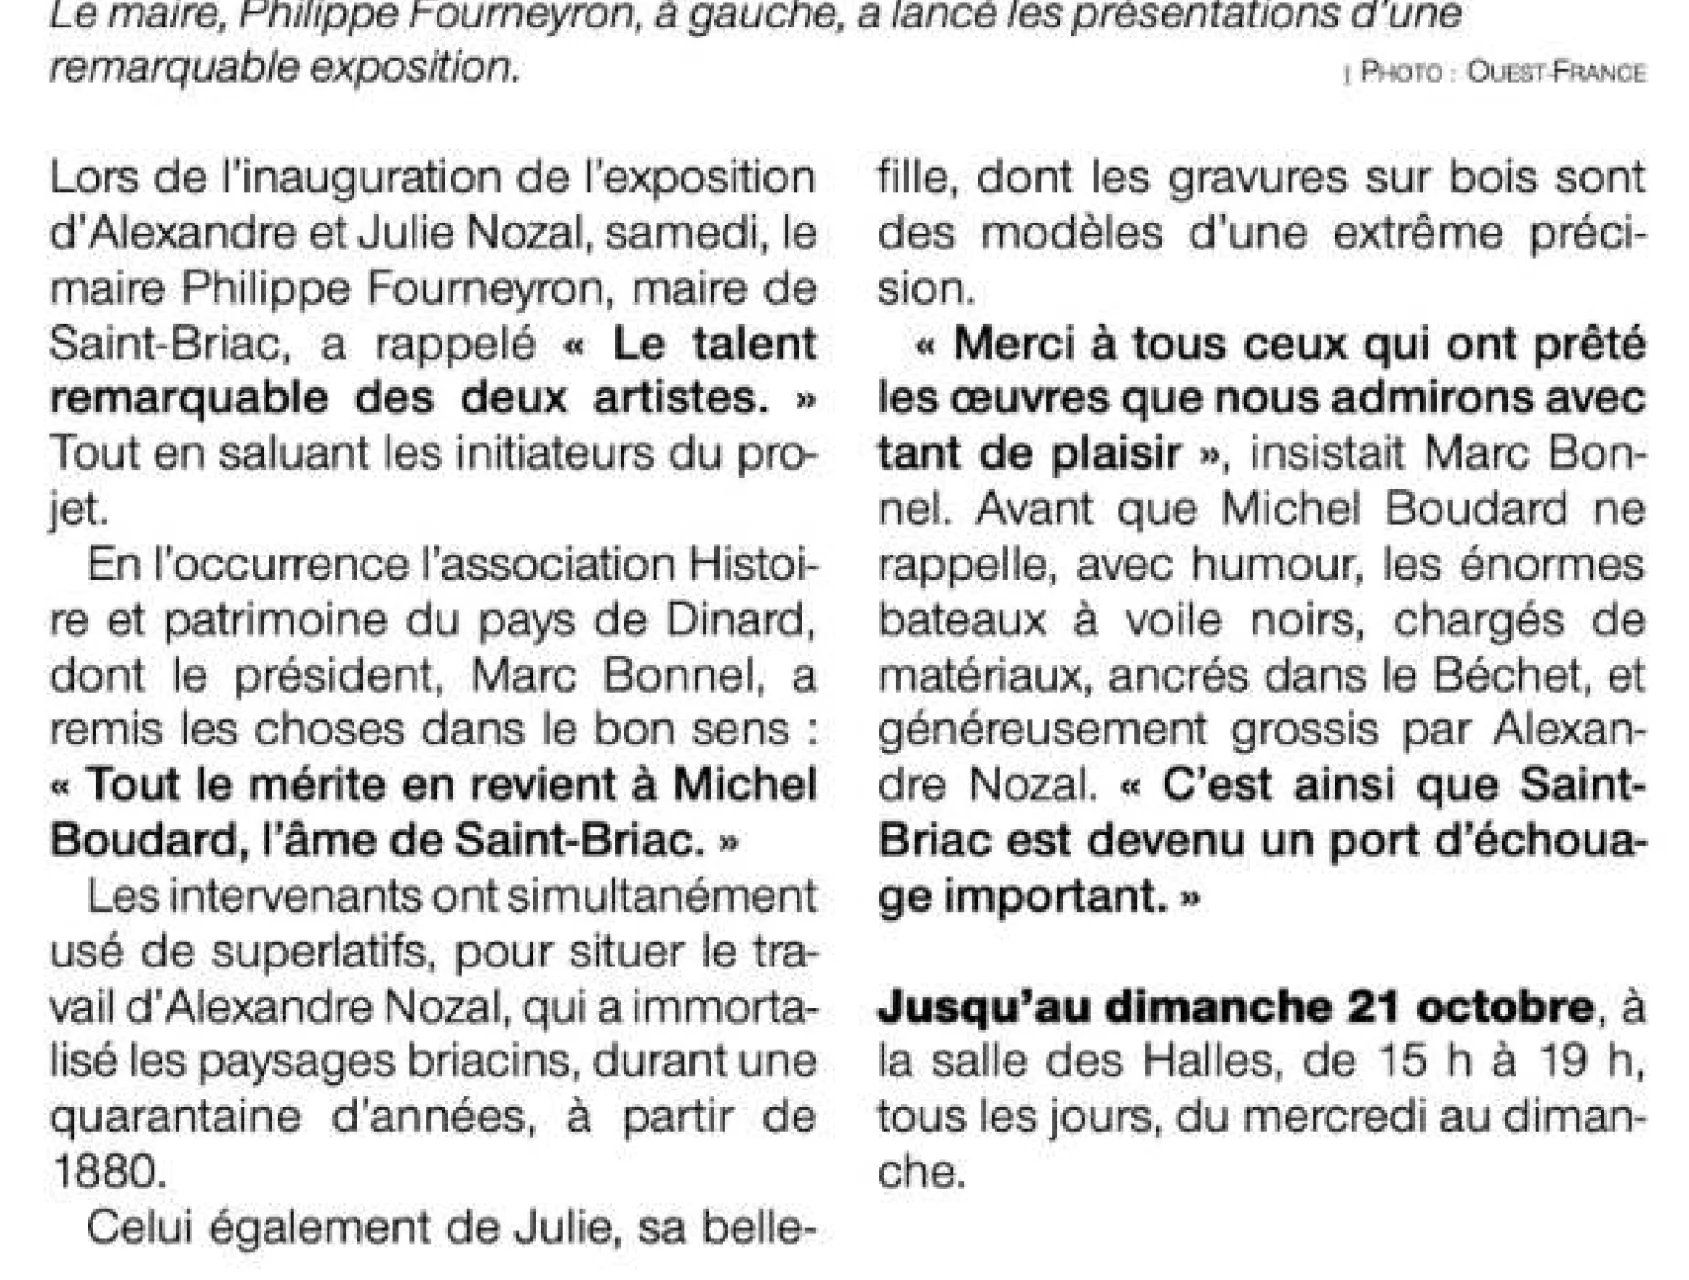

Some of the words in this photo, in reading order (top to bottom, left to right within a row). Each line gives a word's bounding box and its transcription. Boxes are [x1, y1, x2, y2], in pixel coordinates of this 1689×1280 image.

[858, 3, 881, 29] a
[50, 50, 302, 92] remarquable
[311, 50, 521, 92] exposition.
[52, 159, 140, 195] Lors
[154, 157, 208, 195] de
[225, 157, 503, 205] l'inauguration
[516, 159, 571, 195] de
[587, 157, 815, 203] l'exposition
[876, 157, 959, 200] fille,
[978, 159, 1073, 195] dont
[1094, 159, 1151, 195] les
[1170, 167, 1348, 205] gravures
[1367, 167, 1433, 195] sur
[1451, 157, 1538, 195] bois
[1557, 160, 1648, 195] sont
[52, 270, 167, 307] maire
[184, 269, 354, 315] Philippe
[371, 269, 614, 315] Fourneyron,
[635, 269, 750, 307] maire
[764, 269, 818, 307] de
[879, 269, 975, 307] sion.
[879, 379, 941, 417] les
[950, 387, 1112, 417] œuvres
[1123, 387, 1205, 425] que
[1217, 387, 1323, 417] nous
[1332, 376, 1537, 417] admirons
[1546, 387, 1648, 417] avec
[49, 433, 142, 472] Tout
[154, 442, 206, 472] en
[219, 434, 370, 472] saluant
[385, 434, 444, 472] les
[458, 434, 656, 472] initiateurs
[670, 434, 722, 472] du
[739, 443, 818, 480] pro-
[49, 489, 109, 535] jet.
[882, 489, 952, 527] nel.
[975, 489, 1096, 527] Avant
[1118, 497, 1199, 534] que
[1225, 489, 1362, 527] Michel
[1387, 489, 1568, 527] Boudard
[1596, 497, 1647, 527] ne
[880, 545, 1057, 590] rappelle,
[1077, 555, 1175, 582] avec
[1193, 545, 1365, 587] humour,
[1385, 545, 1442, 582] les
[1461, 544, 1646, 582] énormes
[52, 609, 90, 639] re
[109, 602, 147, 639] et
[167, 601, 390, 647] patrimoine
[407, 601, 461, 639] du
[480, 609, 577, 647] pays
[596, 600, 648, 639] de
[668, 598, 815, 643] Dinard,
[882, 601, 1048, 639] bateaux
[1074, 599, 1100, 639] à
[1126, 601, 1224, 639] voile
[1253, 601, 1365, 643] noirs,
[1395, 599, 1566, 647] chargés
[1593, 602, 1647, 639] de
[52, 656, 147, 695] dont
[176, 656, 208, 695] le
[236, 656, 444, 702] président,
[473, 656, 578, 695] Marc
[605, 656, 765, 699] Bonnel,
[794, 665, 818, 695] a
[880, 656, 1093, 700] matériaux,
[1109, 656, 1249, 695] ancrés
[1266, 656, 1368, 695] dans
[1384, 656, 1417, 695] le
[1436, 656, 1592, 699] Béchet,
[1610, 659, 1647, 695] et
[879, 709, 1209, 757] généreusement
[1233, 711, 1380, 757] grossis
[1404, 719, 1474, 755] par
[1494, 709, 1648, 746] Alexan-
[91, 877, 161, 914] Les
[170, 877, 425, 915] intervenants
[432, 879, 500, 915] ont
[508, 876, 818, 915] simultanément
[52, 931, 126, 970] usé
[142, 931, 197, 969] de
[212, 931, 436, 978] superlatifs,
[456, 941, 557, 978] pour
[571, 932, 688, 969] situer
[703, 931, 738, 969] le
[753, 935, 821, 969] tra-
[876, 989, 1093, 1032] Jusqu'au
[1105, 987, 1334, 1027] dimanche
[1348, 989, 1398, 1024] 21
[1417, 989, 1606, 1029] octobre,
[1623, 987, 1648, 1027] à
[52, 1041, 119, 1079] lisé
[131, 1041, 189, 1079] les
[201, 1050, 398, 1088] paysages
[409, 1041, 582, 1084] briacins,
[593, 1041, 730, 1079] durant
[739, 1050, 818, 1079] une
[880, 1041, 914, 1079] la
[933, 1041, 1029, 1079] salle
[1046, 1041, 1125, 1079] des
[1145, 1041, 1284, 1084] Halles,
[1304, 1041, 1356, 1079] de
[1382, 1041, 1428, 1079] 15
[1450, 1041, 1474, 1079] h
[1494, 1041, 1518, 1079] à
[1543, 1041, 1590, 1079] 19
[1610, 1041, 1645, 1084] h,
[876, 1099, 969, 1134] tous
[981, 1099, 1038, 1134] les
[1049, 1097, 1164, 1142] jours,
[1176, 1097, 1230, 1134] du
[1244, 1097, 1428, 1134] mercredi
[1440, 1107, 1492, 1134] au
[1505, 1096, 1648, 1134] diman-
[56, 1153, 167, 1191] 1880.
[879, 1153, 966, 1191] che.
[88, 1209, 192, 1246] Celui
[211, 1209, 433, 1254] également
[448, 1209, 502, 1246] de
[514, 1209, 623, 1251] Julie,
[640, 1217, 688, 1246] sa
[703, 1209, 818, 1246] belle-
